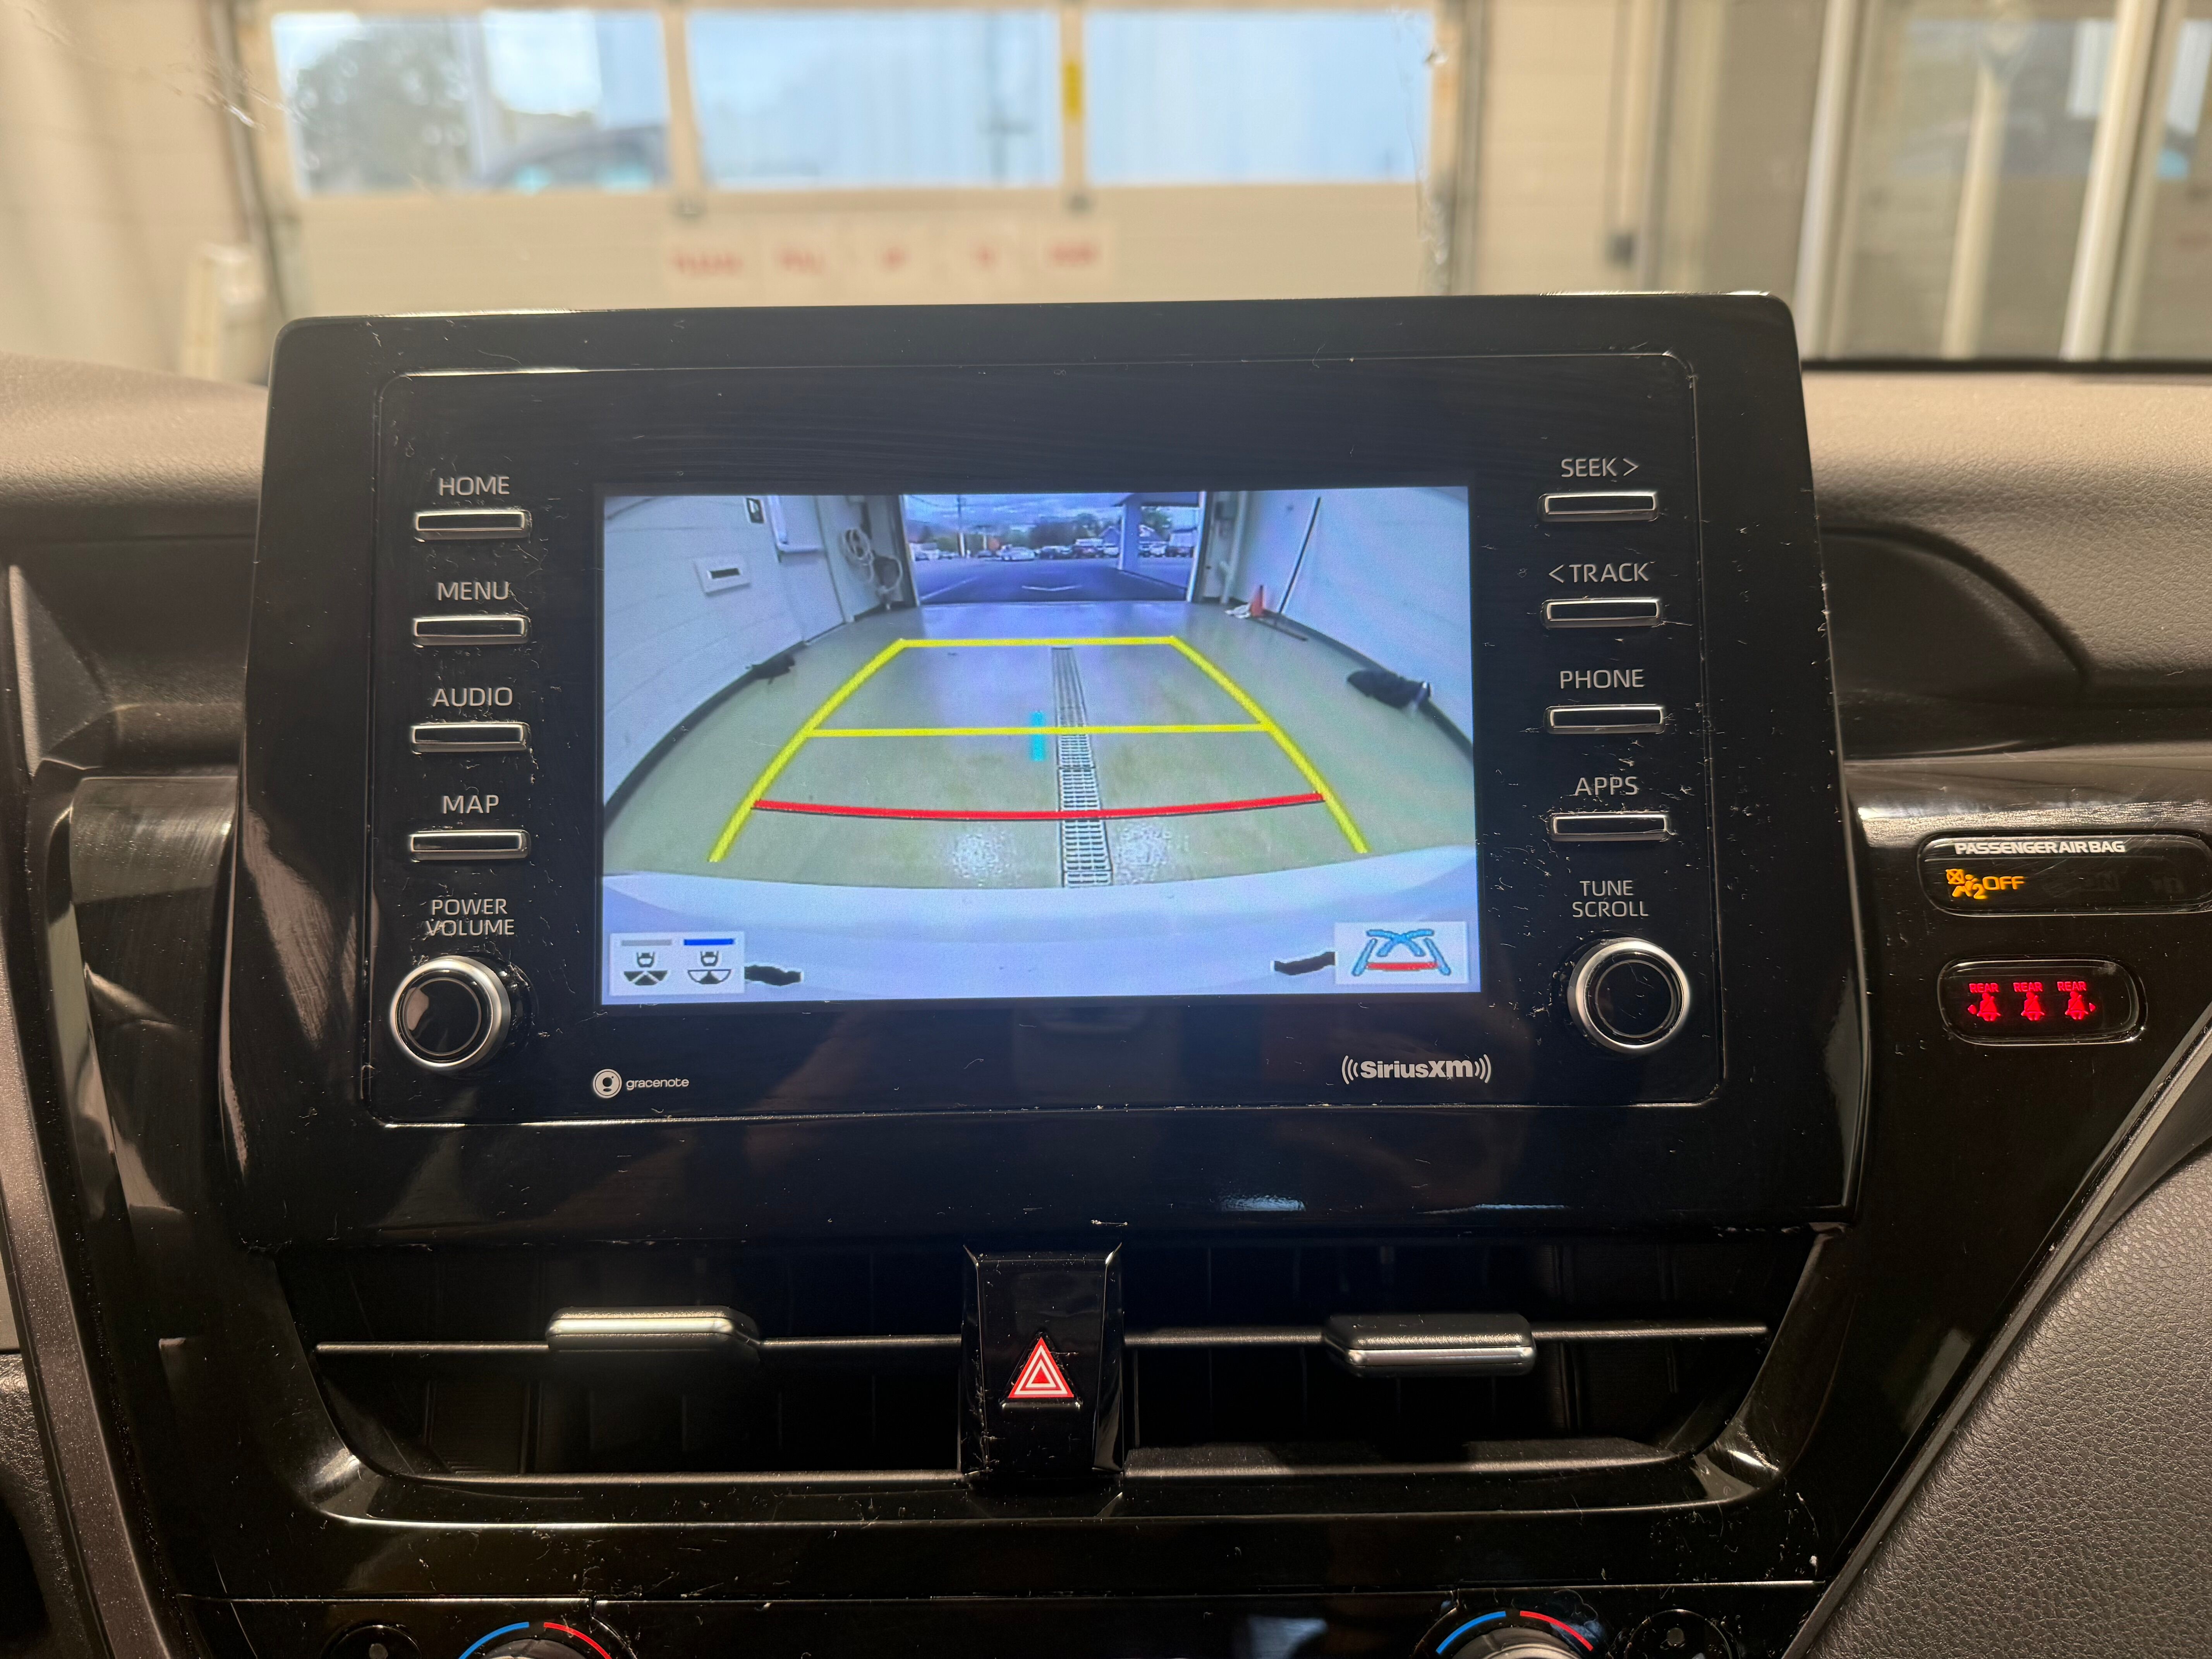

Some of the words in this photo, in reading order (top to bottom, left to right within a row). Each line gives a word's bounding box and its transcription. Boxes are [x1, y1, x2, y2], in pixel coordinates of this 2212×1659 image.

[1561, 457, 1618, 477] SEEK
[439, 476, 510, 496] HOME
[1569, 562, 1650, 582] TRACK
[437, 581, 509, 601] MENU
[1559, 669, 1645, 689] PHONE
[433, 687, 513, 707] AUDIO
[1574, 777, 1639, 796] APPS
[443, 795, 500, 814] MAP
[1580, 880, 1634, 896] TUNE
[1982, 876, 2025, 890] OFF
[431, 899, 507, 915] POWER
[1572, 901, 1649, 918] SCROLL
[426, 919, 514, 936] VOLUME
[1969, 983, 1999, 992] REAR
[2013, 982, 2043, 992] REAR
[2057, 981, 2087, 991] REAR
[626, 1078, 689, 1091] gracenote
